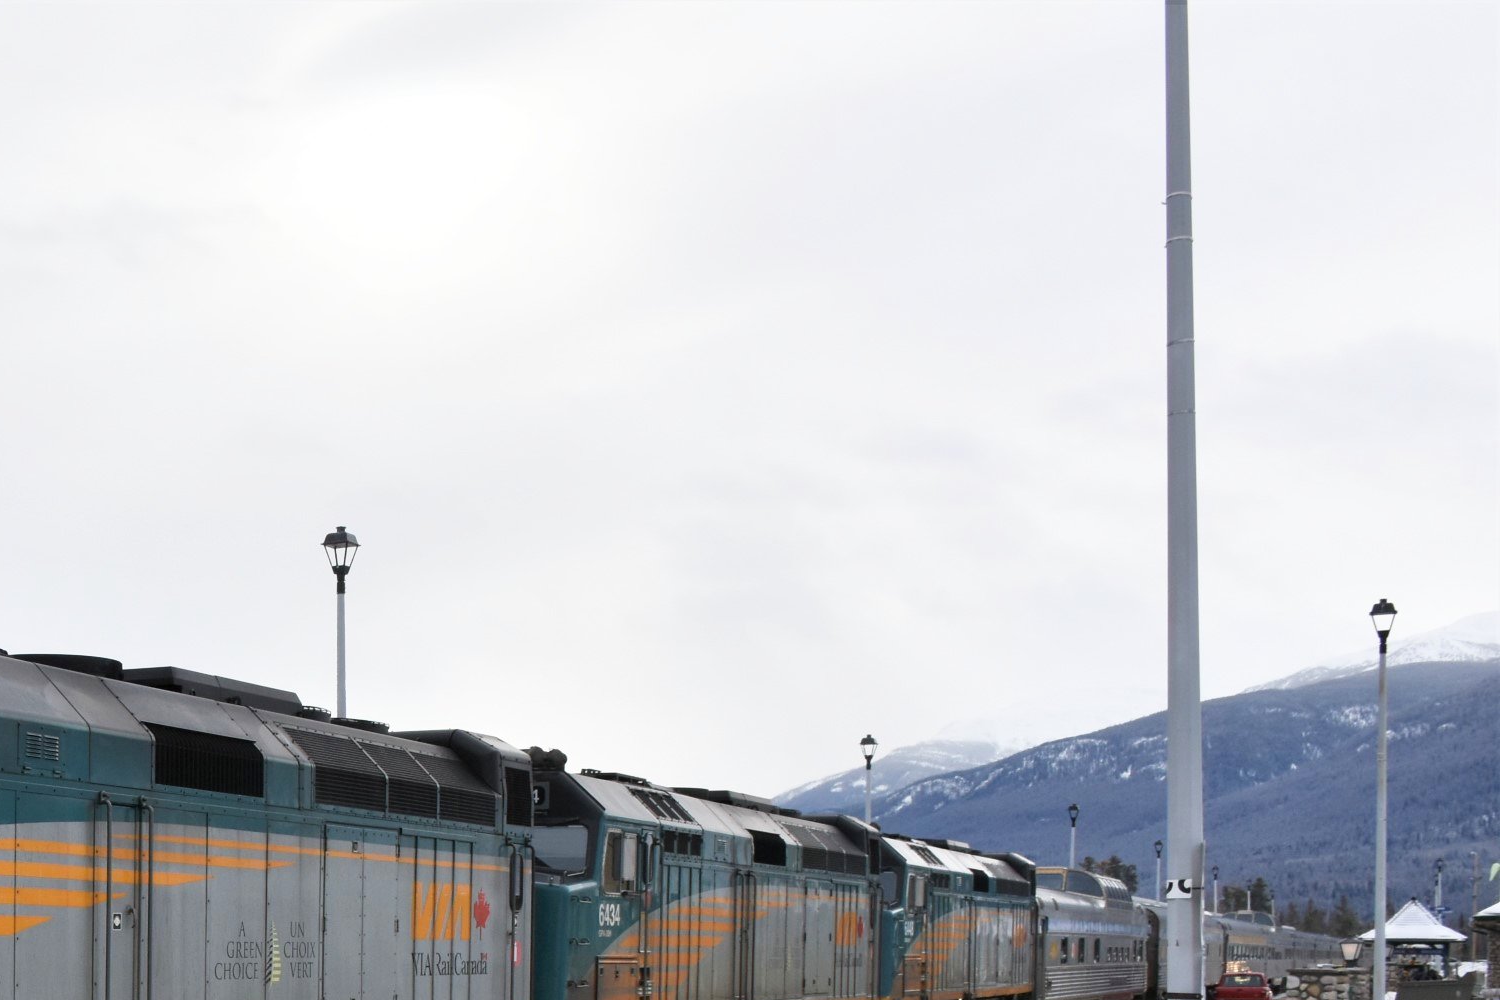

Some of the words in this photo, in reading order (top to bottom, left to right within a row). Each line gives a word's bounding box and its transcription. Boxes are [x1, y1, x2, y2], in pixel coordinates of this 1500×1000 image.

[411, 881, 471, 941] VIA
[598, 903, 621, 927] 6434
[238, 921, 246, 938] A
[290, 921, 305, 938] UN
[226, 941, 263, 959] GREEN
[283, 941, 316, 959] CHOIX
[214, 962, 259, 981] CHOICE
[290, 962, 314, 979] VERT
